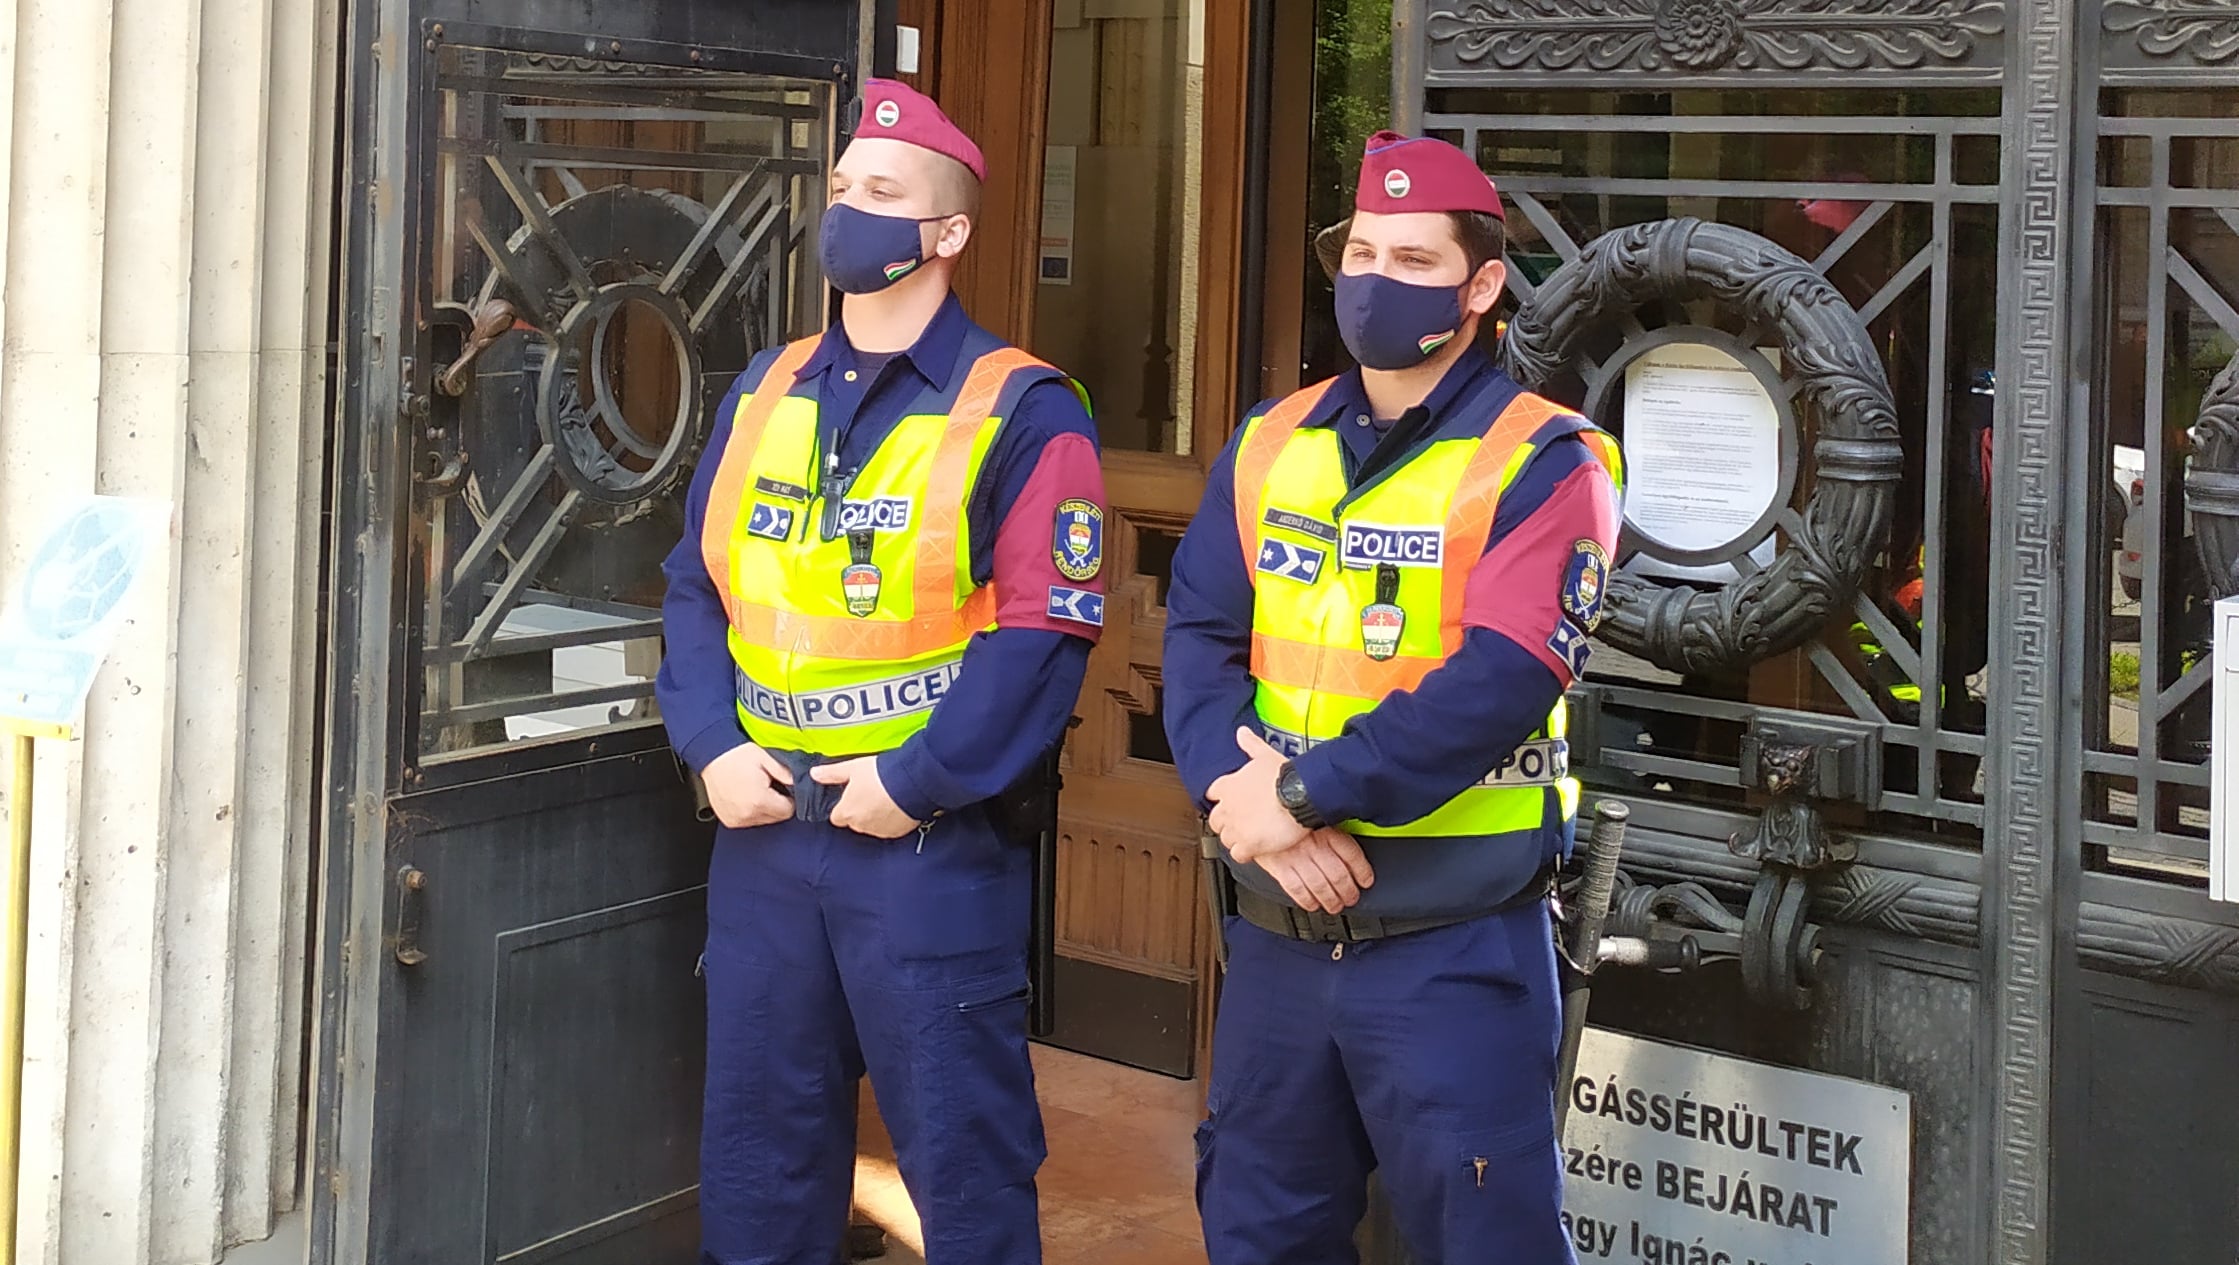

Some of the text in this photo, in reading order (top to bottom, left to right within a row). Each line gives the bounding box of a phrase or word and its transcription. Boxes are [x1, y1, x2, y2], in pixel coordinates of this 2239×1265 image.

[1346, 530, 1438, 560] POLICE
[802, 672, 944, 722] POLICE
[1572, 1074, 1863, 1176] GÁSSÉRÜLTEK
[1656, 1160, 1838, 1237] BEJÁRAT
